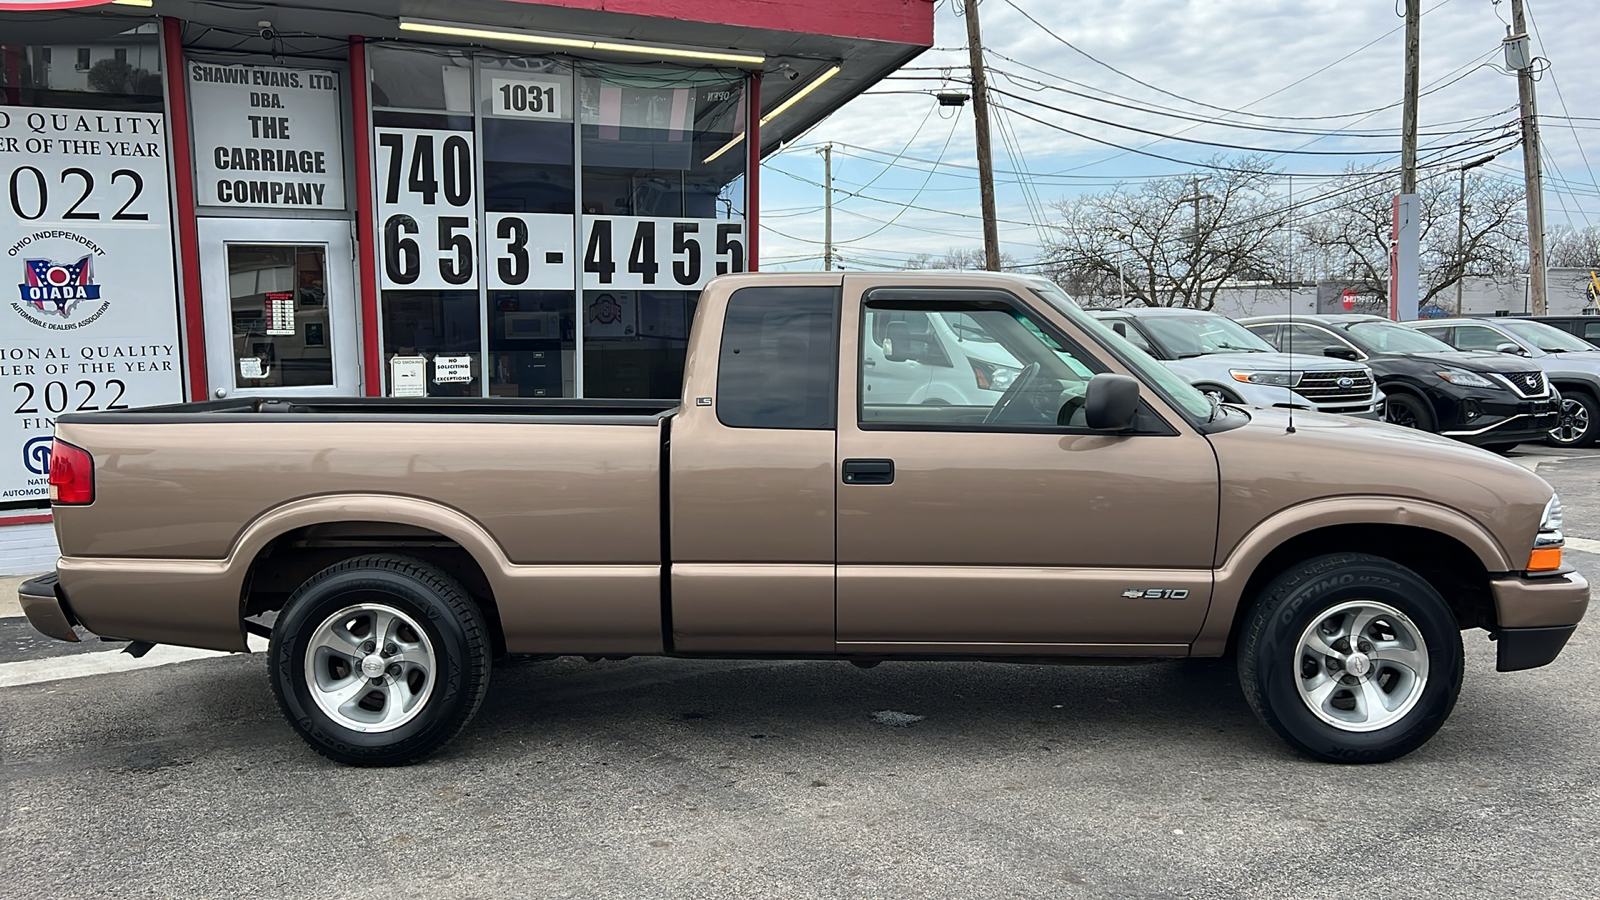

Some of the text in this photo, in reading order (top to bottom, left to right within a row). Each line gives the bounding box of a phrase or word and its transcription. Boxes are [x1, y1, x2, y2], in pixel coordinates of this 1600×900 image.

[192, 65, 337, 91] SHAWN EVANS. LTD.
[250, 92, 285, 109] DBA.
[499, 83, 555, 113] 1031
[27, 112, 161, 135] QUALITY
[247, 115, 290, 140] THE
[25, 137, 53, 154] OF
[58, 139, 102, 156] THE
[106, 141, 161, 158] YEAR
[213, 146, 326, 174] CARRIAGE
[379, 132, 473, 207] 740
[9, 165, 149, 221] 022
[216, 179, 326, 206] COMPANY
[8, 230, 106, 257] OHIO INDEPENDENT
[29, 286, 88, 300] OIADA
[10, 300, 111, 331] AUTOMOBILE DEALERS ASSOCIATION
[0, 345, 174, 360] IONAL QUALITY
[0, 360, 173, 376] LER OF THE YEAR
[13, 379, 129, 414] 2022
[1144, 588, 1189, 599] S10
[1281, 573, 1355, 625] OPTIMO
